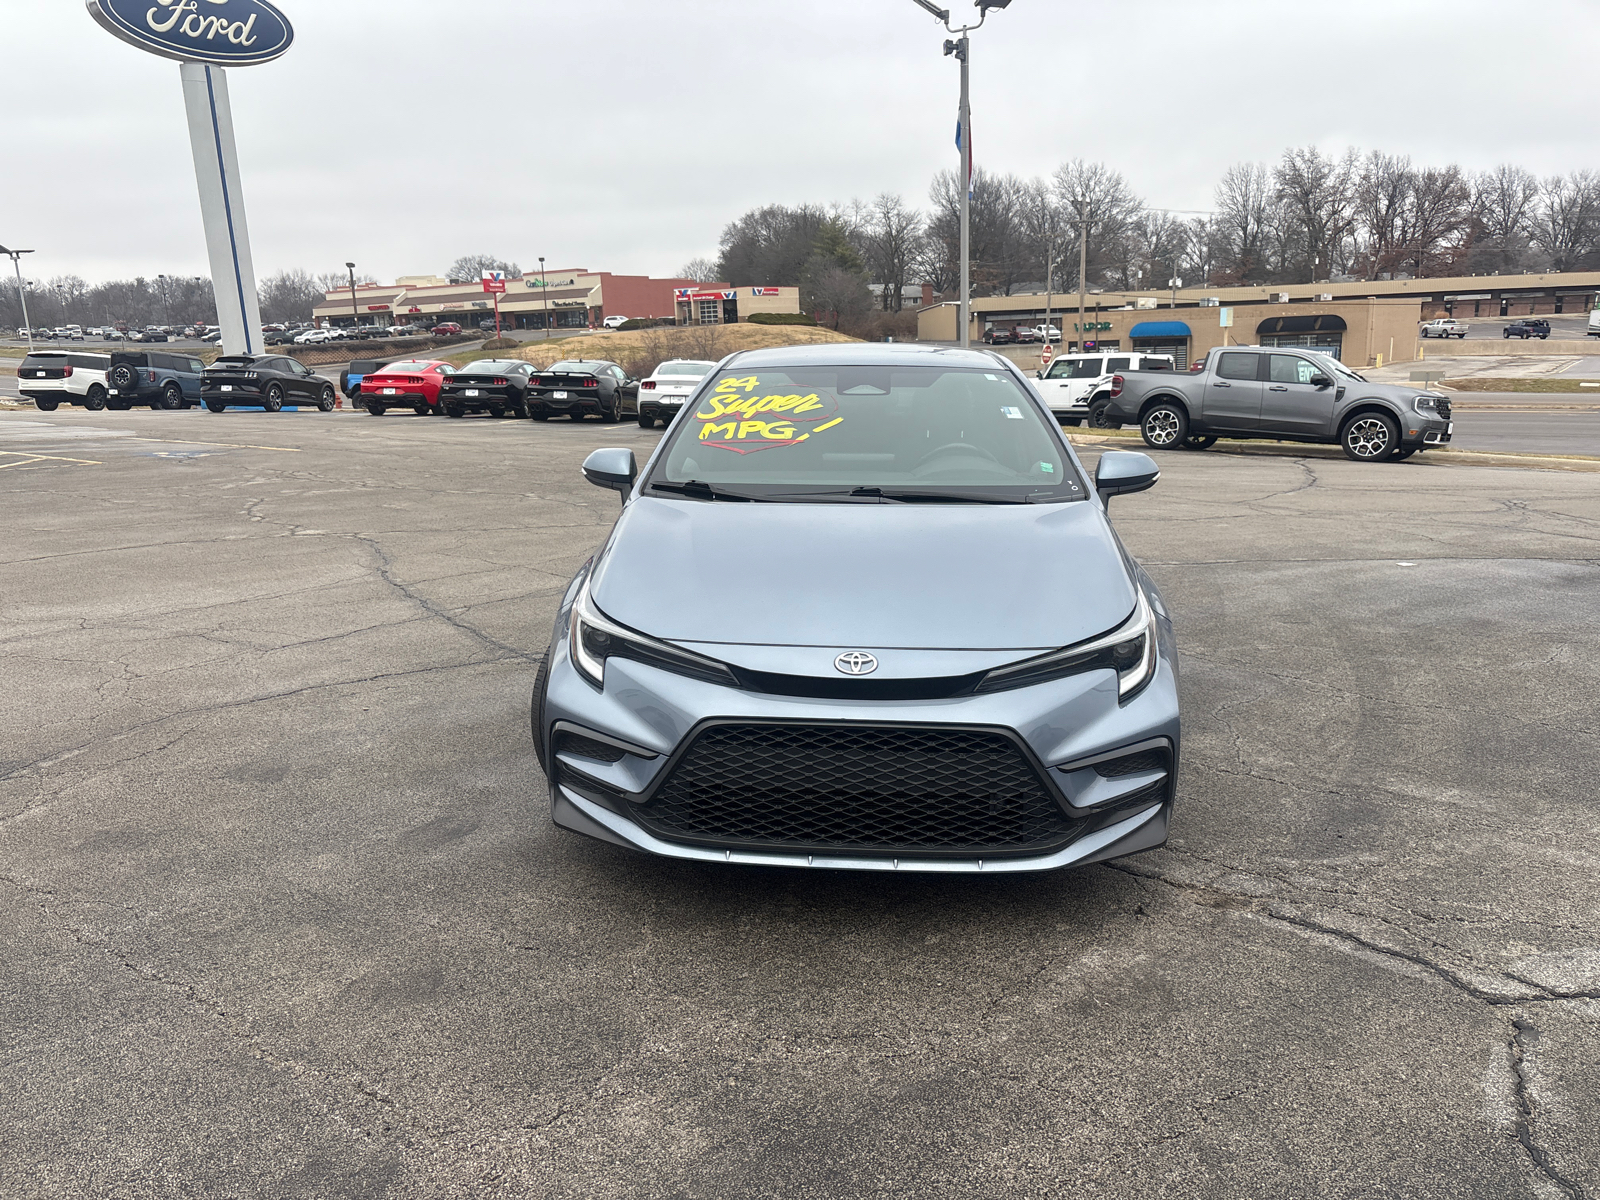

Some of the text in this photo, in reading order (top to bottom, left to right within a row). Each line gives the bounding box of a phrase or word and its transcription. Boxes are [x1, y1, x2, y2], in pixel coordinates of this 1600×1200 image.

[146, 0, 258, 47] Ford
[714, 376, 760, 392] 24
[697, 394, 824, 419] Super
